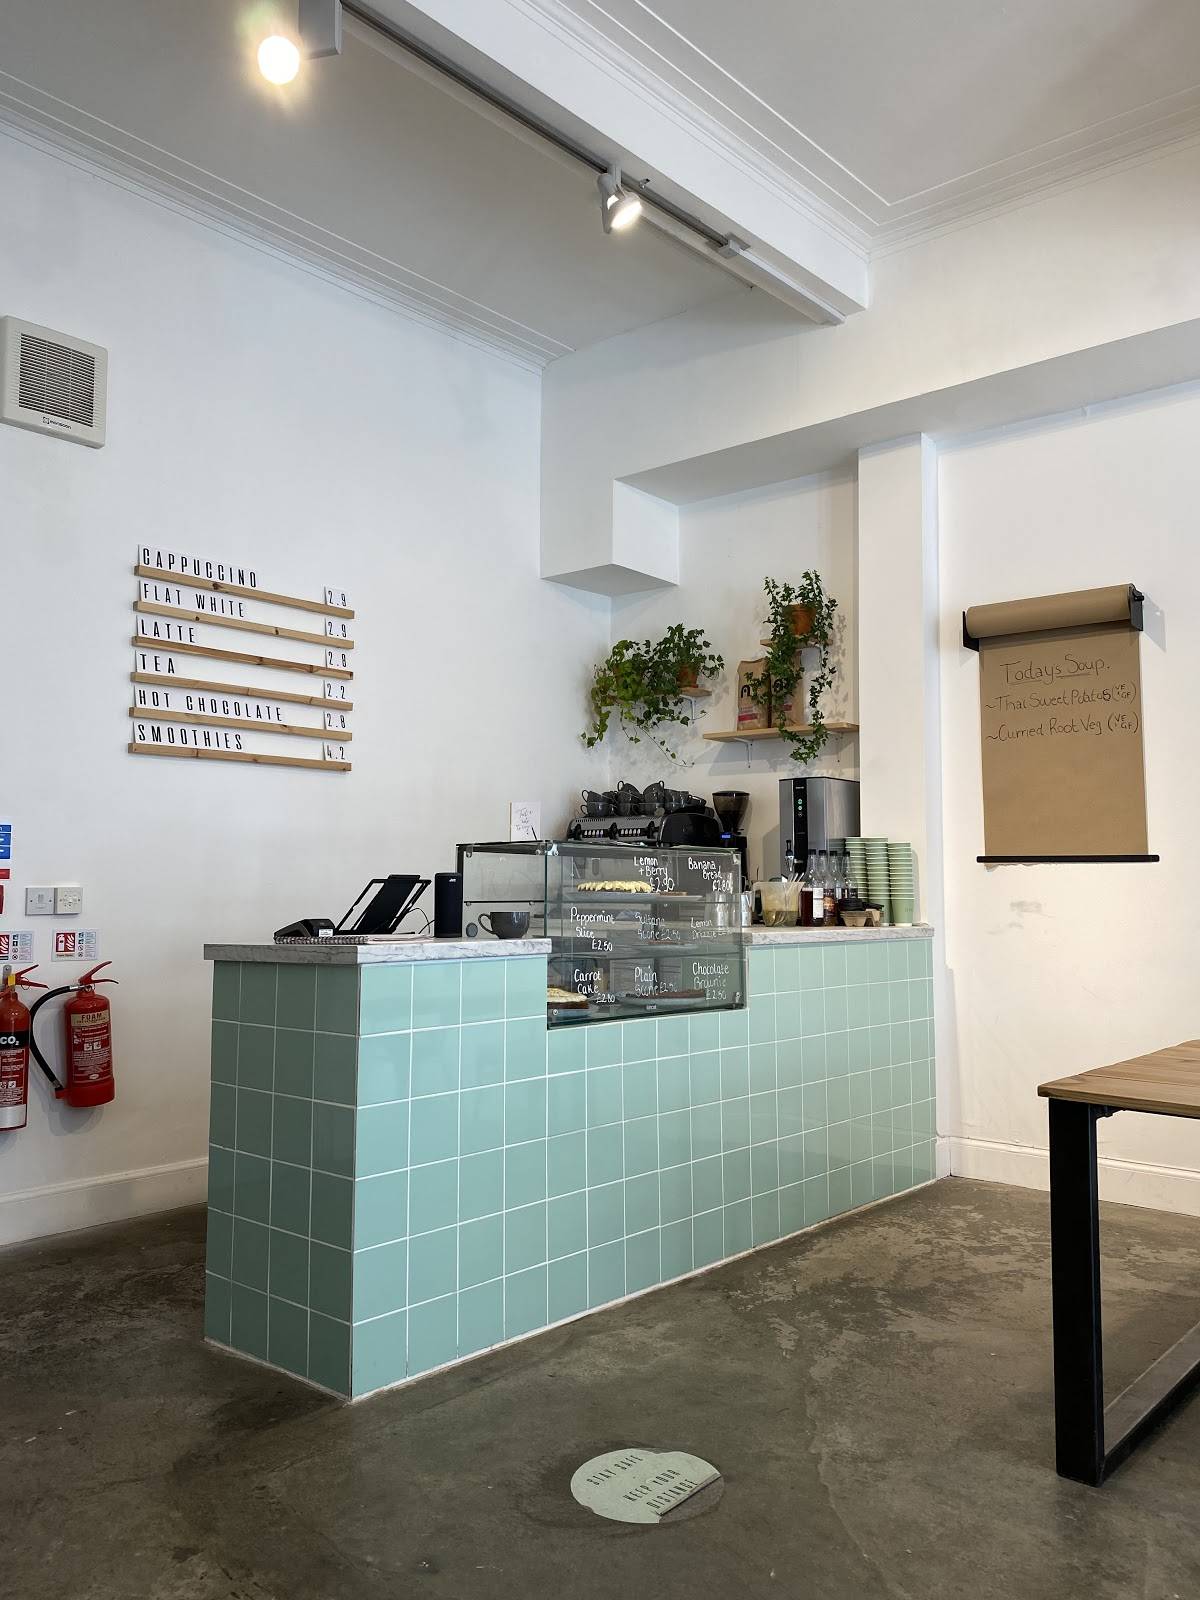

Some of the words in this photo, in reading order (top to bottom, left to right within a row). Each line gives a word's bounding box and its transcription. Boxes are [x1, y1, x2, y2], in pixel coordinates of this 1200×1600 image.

[143, 548, 257, 588] CAPPUCCINO
[143, 583, 181, 605] FLAT
[195, 593, 245, 618] WHITE
[328, 590, 347, 606] 2.9
[141, 619, 195, 643] LATTE
[328, 621, 347, 638] 2.9
[139, 653, 175, 674] TEA
[328, 651, 347, 668] 2.8
[327, 683, 345, 699] 2.2
[1029, 691, 1069, 708] Sweet
[138, 689, 170, 708] HOT
[186, 695, 283, 722] CHOCOLATE
[326, 712, 345, 729] 2.8
[1050, 717, 1080, 736] Root
[1080, 714, 1102, 736] Veg
[137, 723, 243, 750] SMOOTHIES
[633, 856, 659, 866] Lemon
[687, 857, 716, 870] Banana
[702, 866, 722, 880] Bread
[570, 907, 616, 925] Peppermint
[691, 917, 713, 928] Lemon
[576, 927, 595, 939] Slice
[574, 969, 602, 982] Carrot
[634, 965, 658, 982] Plain
[692, 962, 730, 975] Chocolate
[577, 983, 600, 994] Cake
[81, 1012, 102, 1021] FOAM
